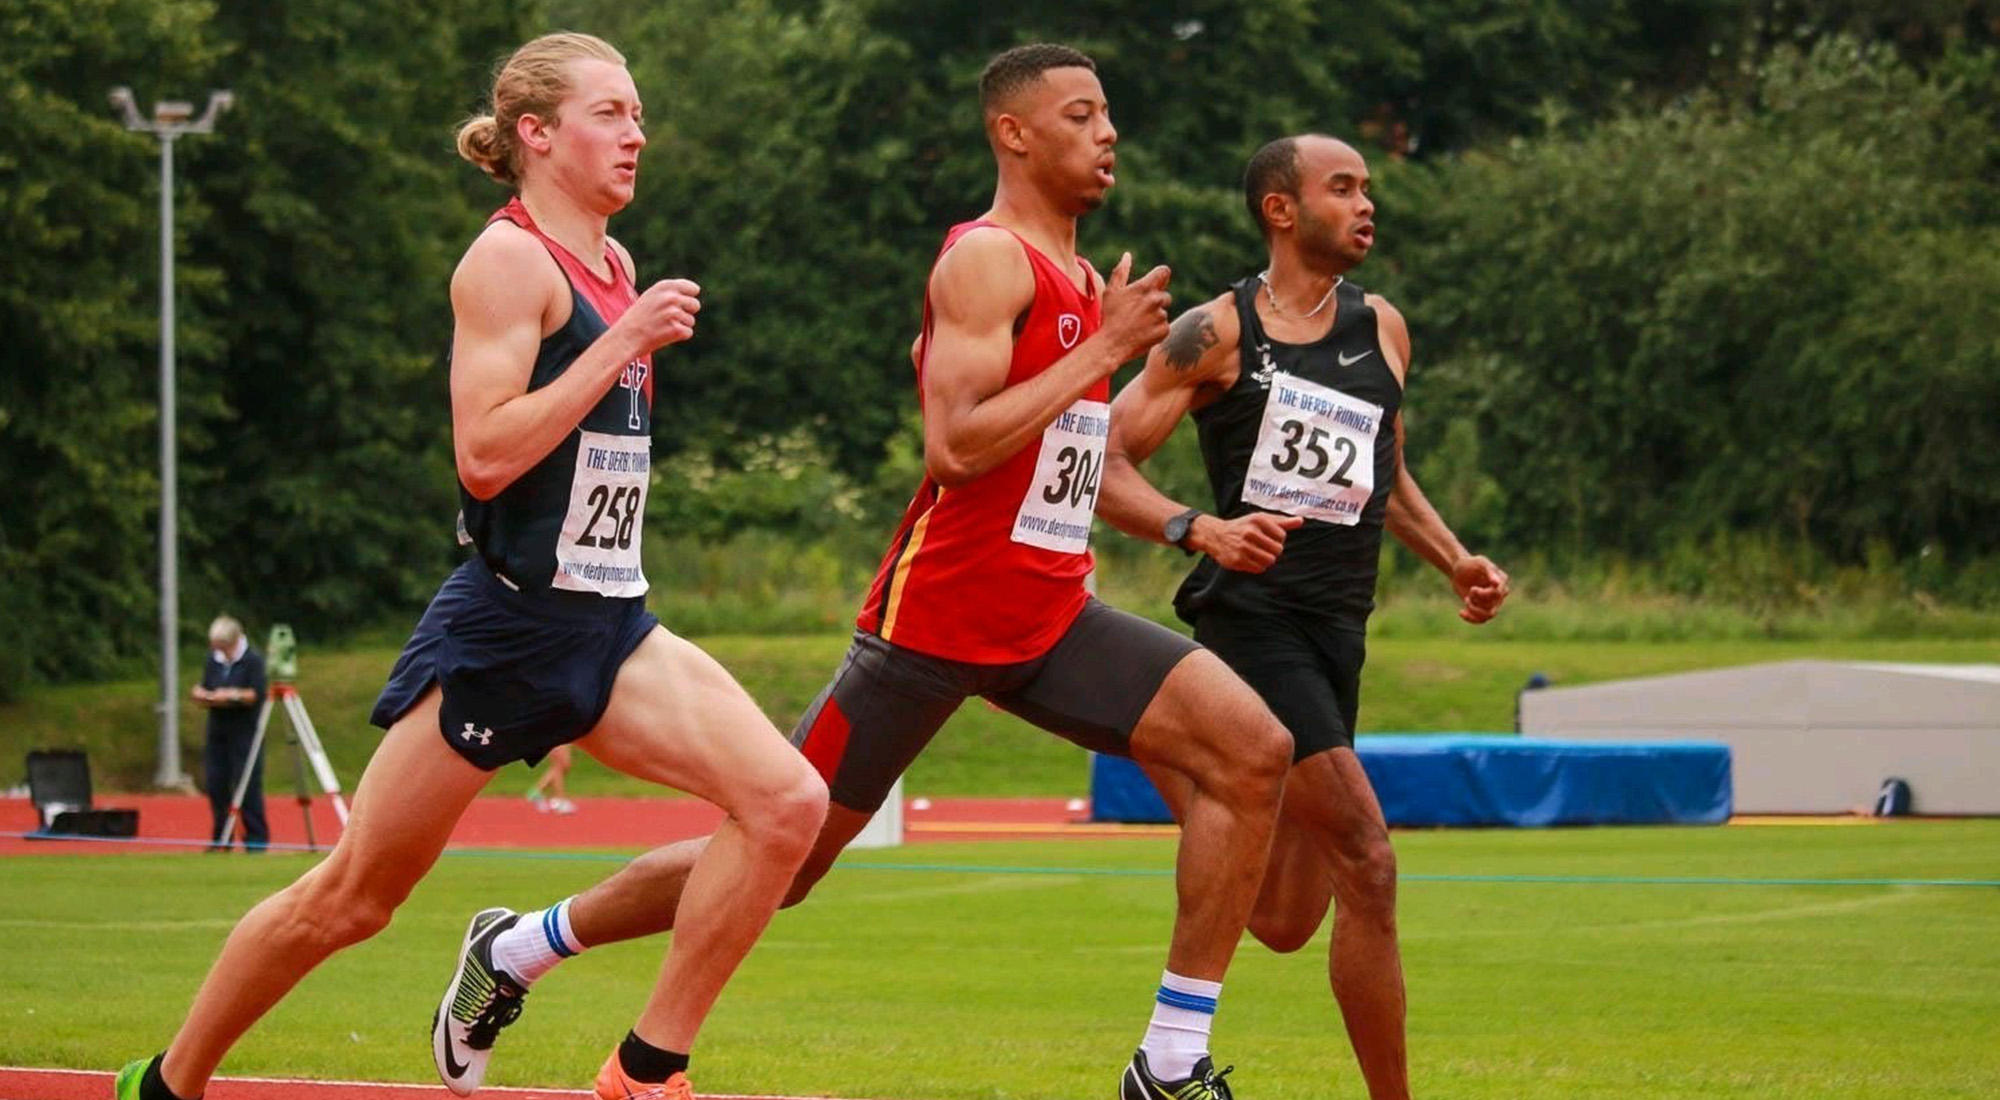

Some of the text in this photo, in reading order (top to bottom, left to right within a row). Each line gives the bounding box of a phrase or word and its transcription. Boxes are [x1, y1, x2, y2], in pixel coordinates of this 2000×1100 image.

[1055, 411, 1078, 433] THE
[1278, 386, 1374, 435] THE DERBY RUNNER
[586, 447, 608, 471] THE
[1043, 446, 1103, 511] 304
[1270, 419, 1358, 489] 352
[574, 484, 641, 551] 258
